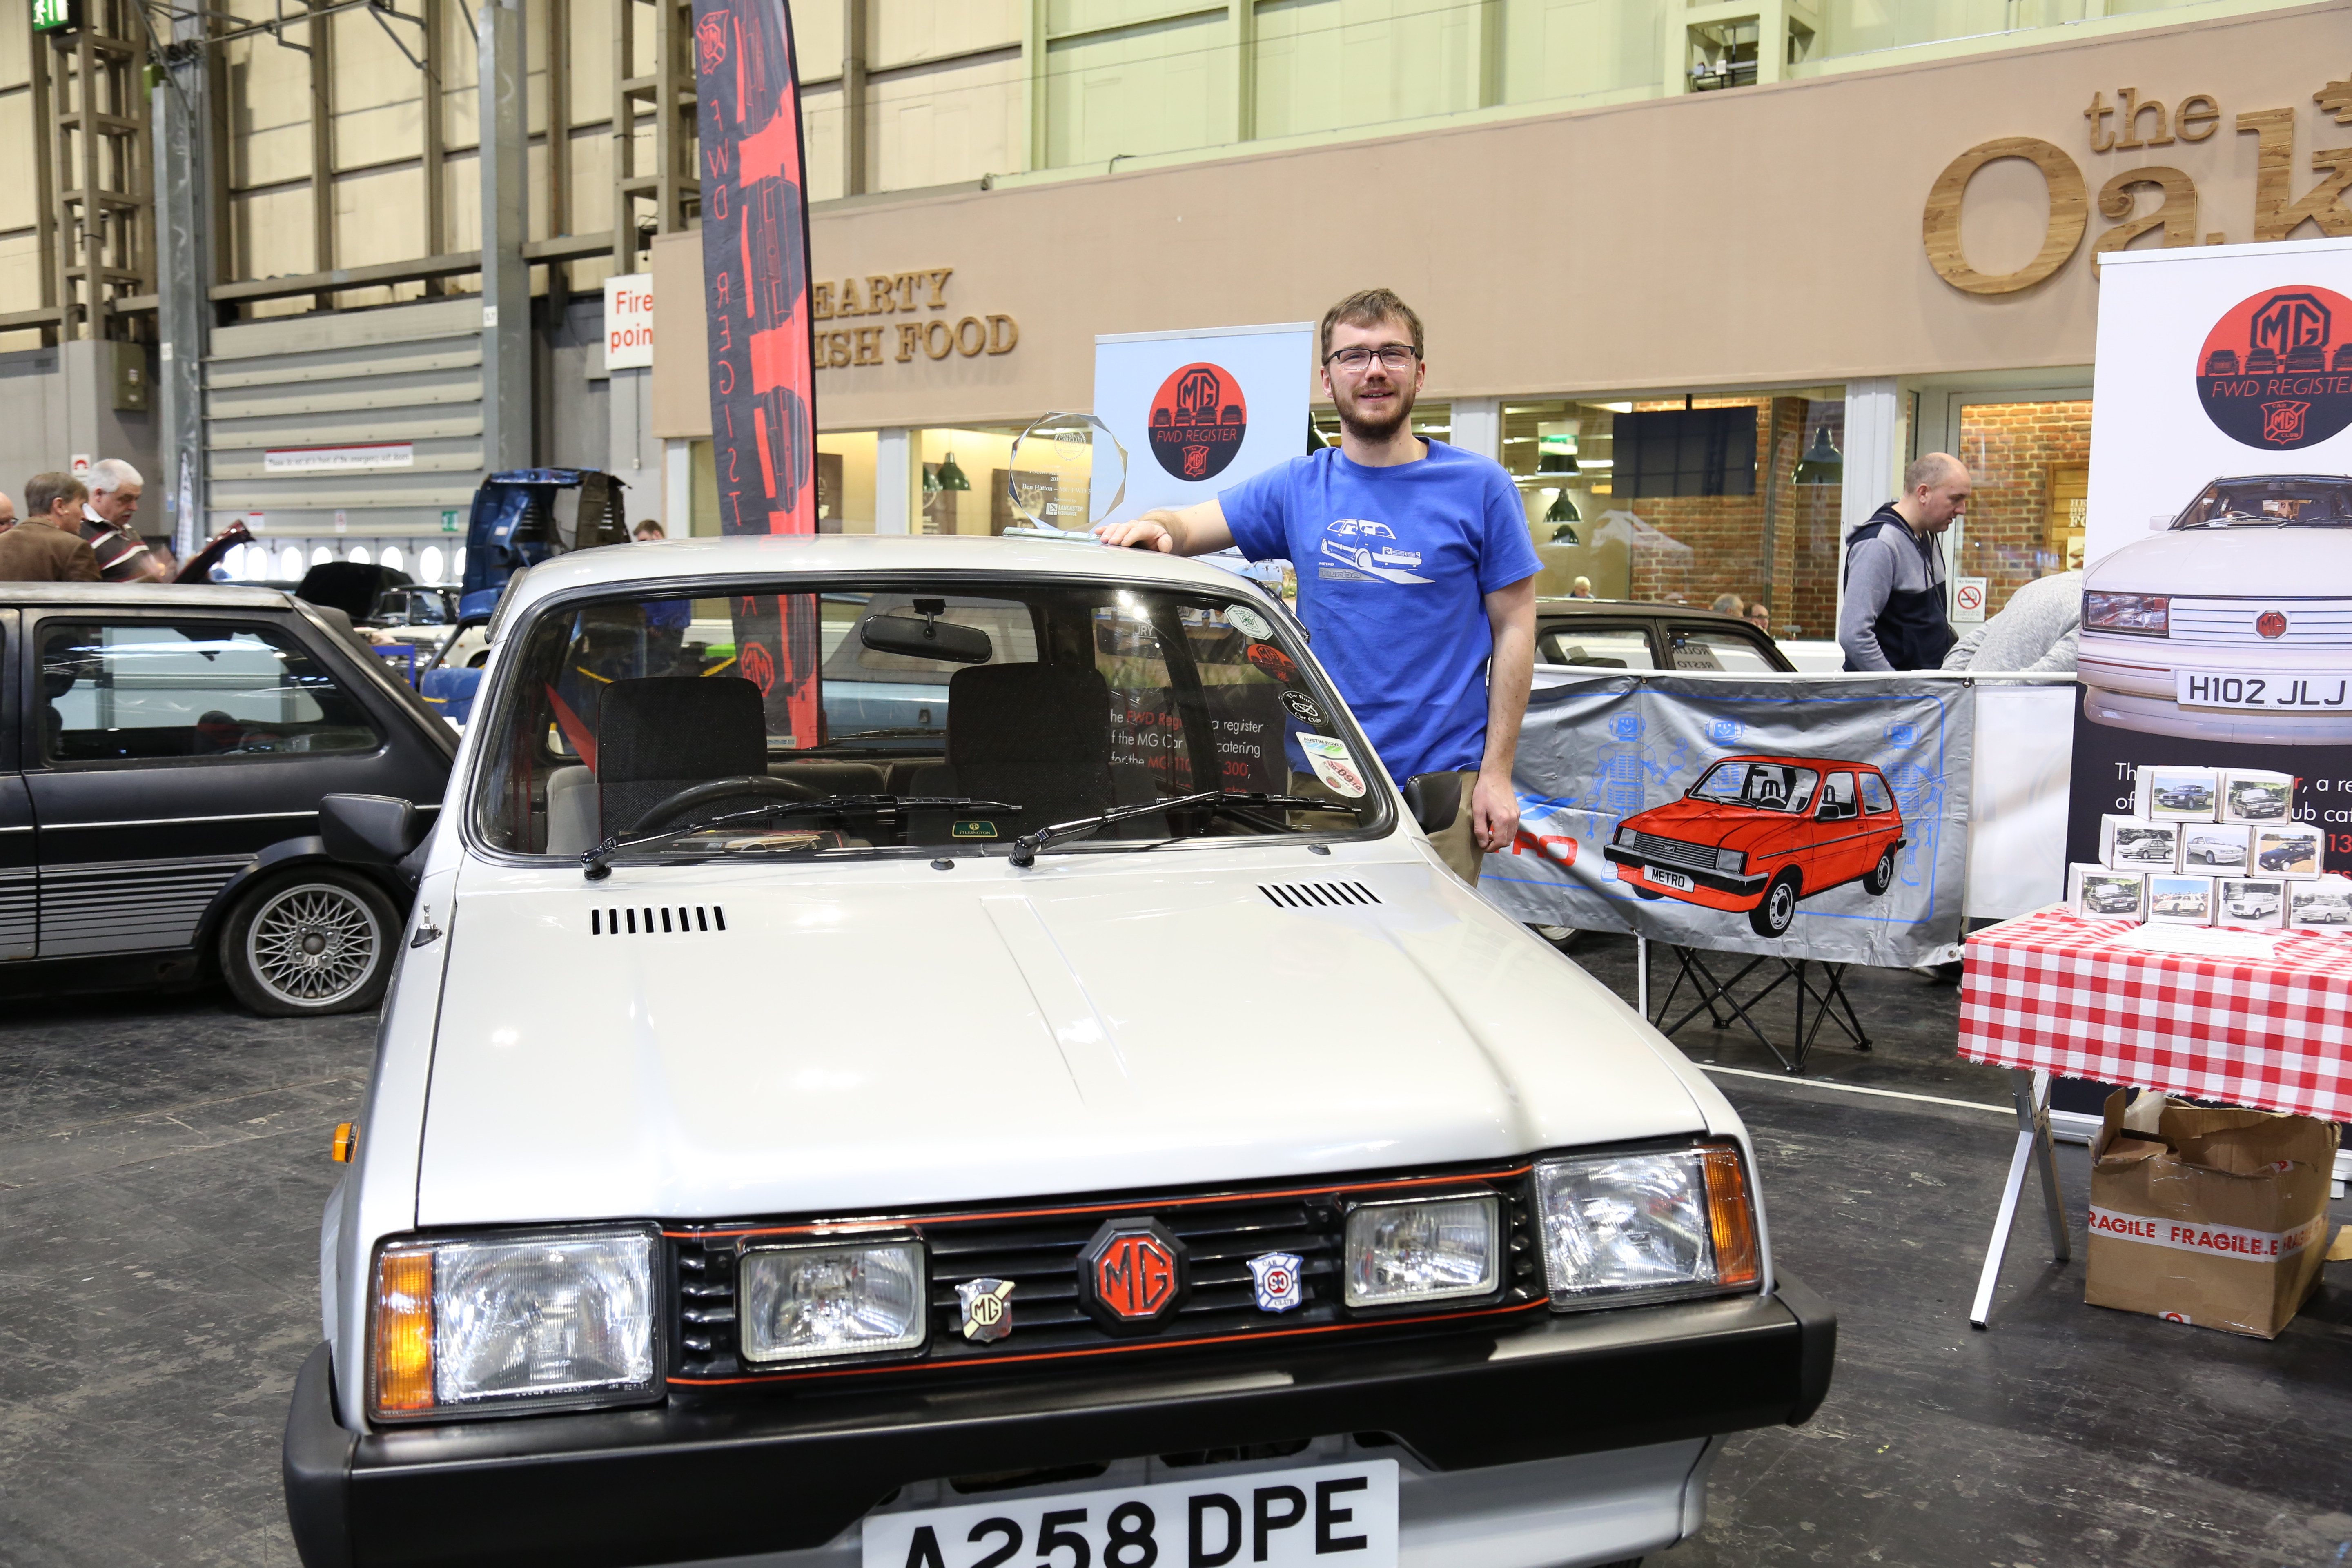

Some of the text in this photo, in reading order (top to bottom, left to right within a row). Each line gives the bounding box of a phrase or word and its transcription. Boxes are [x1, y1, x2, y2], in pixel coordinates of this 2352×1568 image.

[2084, 87, 2220, 152] the
[617, 290, 653, 314] Fire
[813, 268, 953, 320] EARTY
[2257, 300, 2327, 354] MG
[611, 323, 653, 354] poin
[814, 314, 1019, 369] ISH FOOD
[1180, 373, 1217, 411] MG
[2212, 376, 2352, 397] FWD REGISTE
[2274, 412, 2294, 429] MG
[1156, 428, 1237, 443] FWD REGISTER
[1190, 453, 1201, 466] MG
[1320, 569, 1361, 579] Turbo
[1299, 695, 1314, 705] Knot
[2189, 675, 2347, 706] H102 JLJ
[1110, 708, 1123, 723] he
[1127, 710, 1155, 725] FWD
[1294, 712, 1306, 720] Car
[1223, 719, 1264, 735] register
[1111, 729, 1183, 748] f the MG Car
[1216, 741, 1261, 758] catering
[1223, 761, 1251, 779] 300,
[2115, 762, 2136, 781] Th
[2316, 779, 2329, 791] a
[1651, 868, 1685, 888] METRO
[2089, 1210, 2156, 1238] RAGILE
[2170, 1226, 2261, 1256] FRAGILE
[1101, 1238, 1171, 1312] MG
[974, 1297, 999, 1323] MG
[904, 1475, 1368, 1568] A258 DPE
